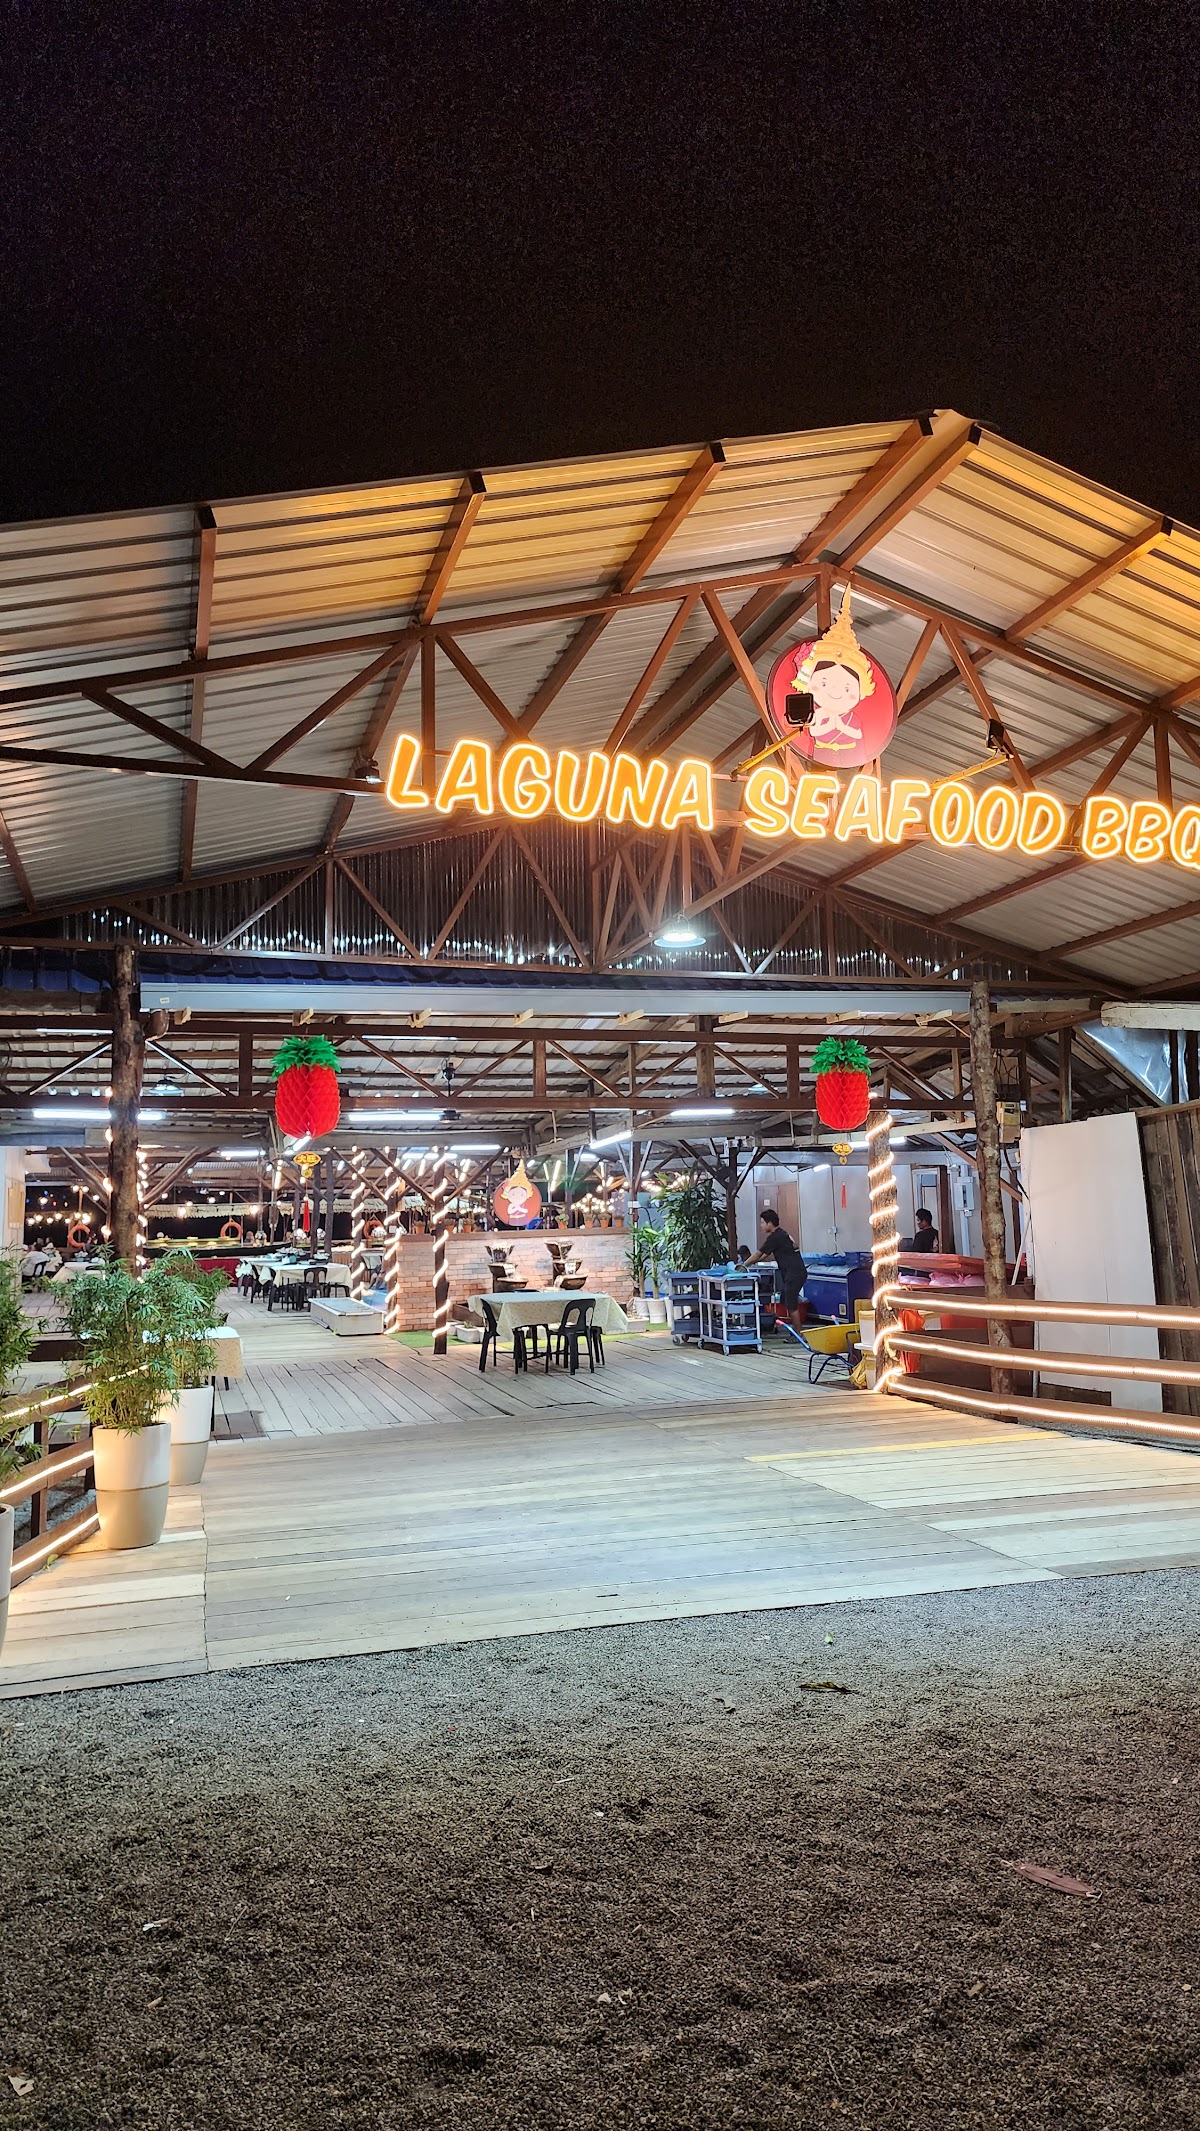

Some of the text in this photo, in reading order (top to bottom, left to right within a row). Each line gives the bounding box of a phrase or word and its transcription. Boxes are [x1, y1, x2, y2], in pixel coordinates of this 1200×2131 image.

[386, 733, 1200, 869] LAGUNA SEAFOOD BBQ
